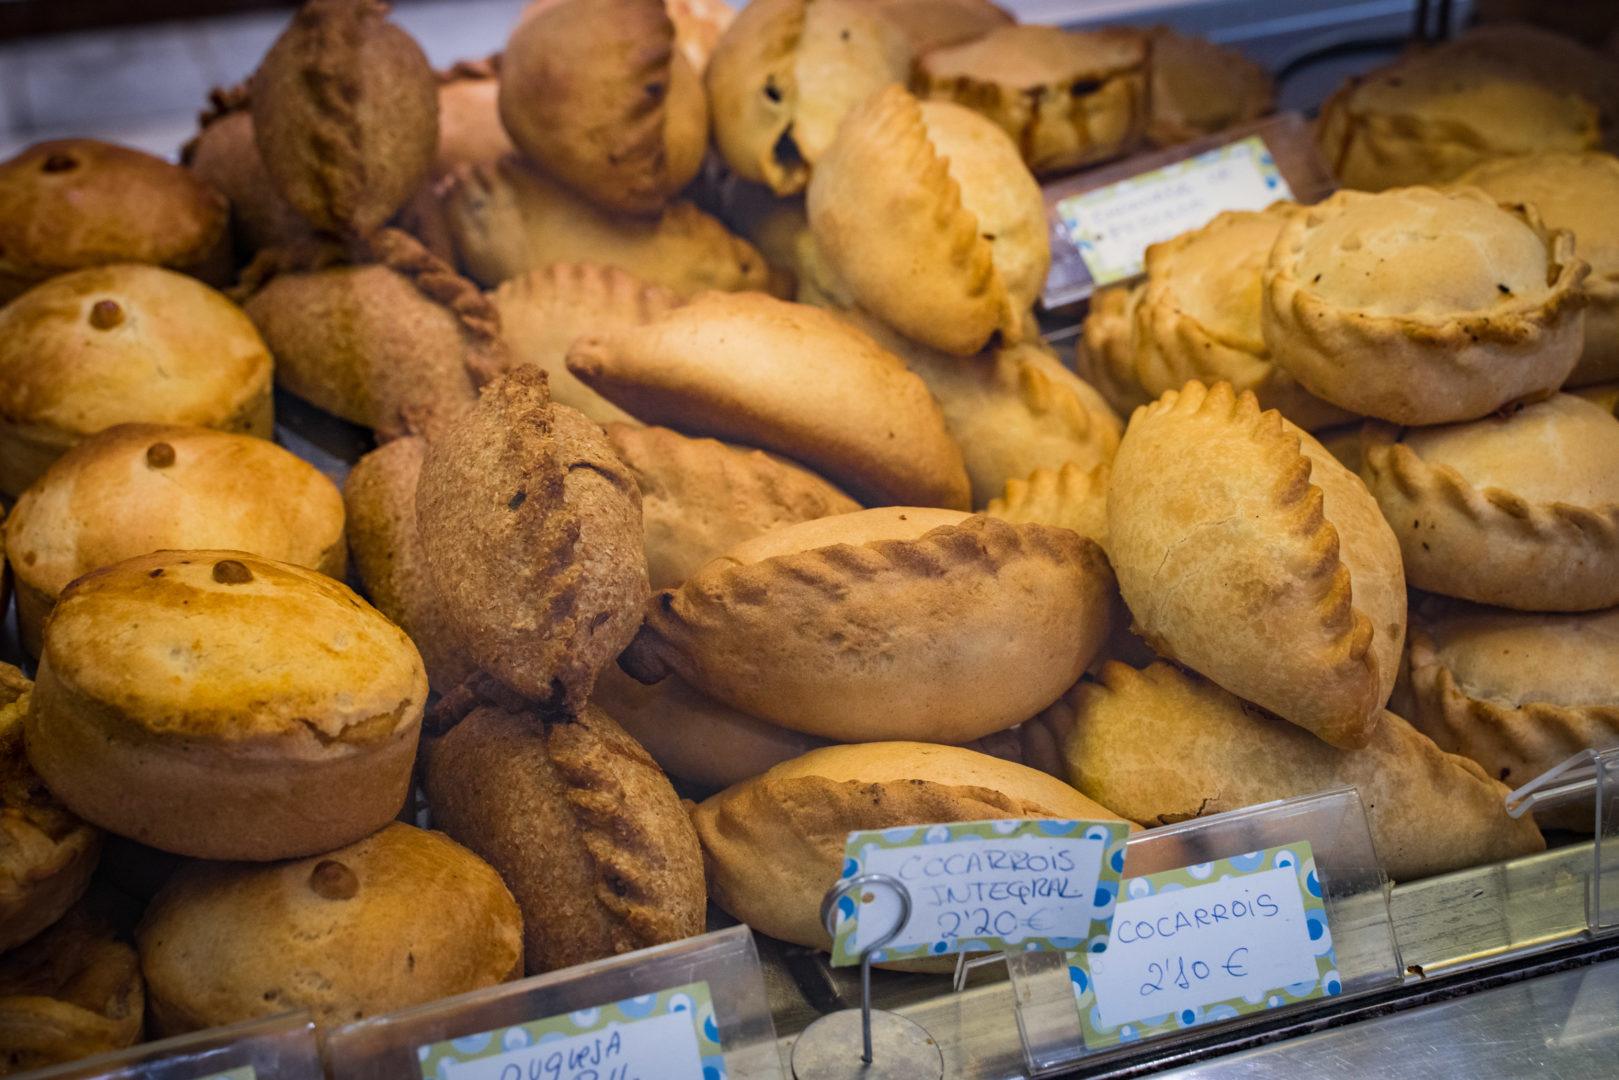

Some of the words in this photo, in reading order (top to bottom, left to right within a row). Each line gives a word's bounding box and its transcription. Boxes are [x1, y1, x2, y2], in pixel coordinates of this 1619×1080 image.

[899, 846, 1076, 880] COCARROIS
[920, 876, 1084, 906] INTEGRAL
[1117, 888, 1280, 944] COCARROIS
